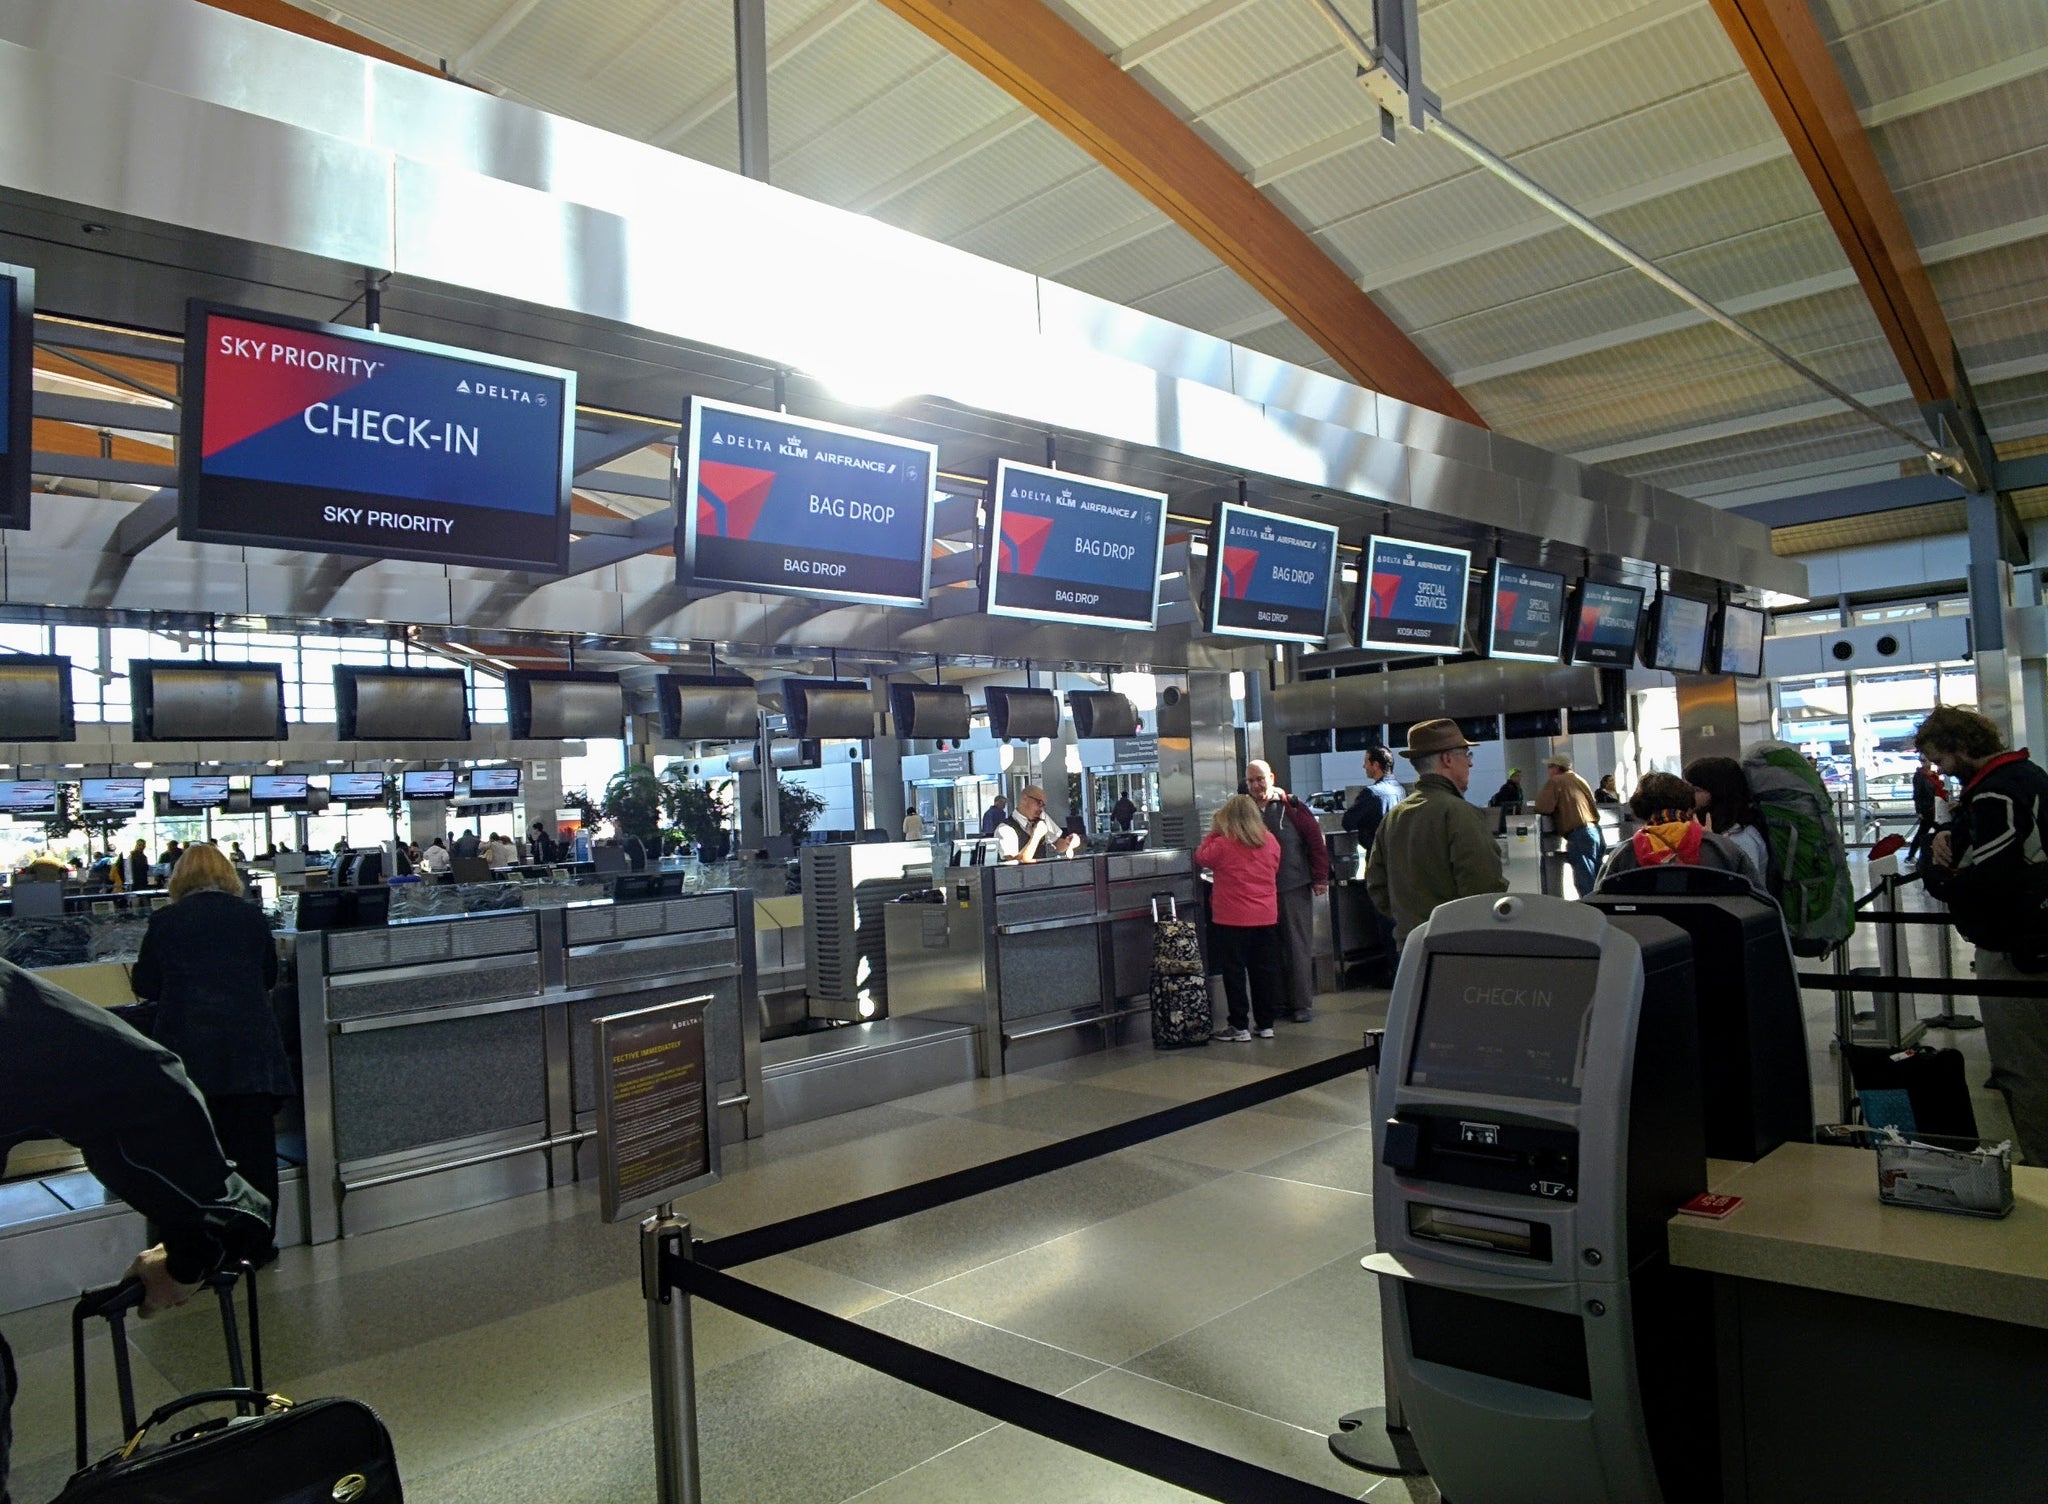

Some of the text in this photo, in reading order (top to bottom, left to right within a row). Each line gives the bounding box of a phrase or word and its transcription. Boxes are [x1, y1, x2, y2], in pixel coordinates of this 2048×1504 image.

[220, 335, 267, 360] SKY
[475, 383, 531, 404] DELTA
[304, 402, 478, 457] CHECK-IN
[727, 434, 885, 473] DELTA KLM AIRFRANCE
[809, 494, 895, 524] BAG DROP
[1021, 489, 1130, 518] DELTA KLM AIRFRANCE
[323, 505, 454, 536] SKY PRIORITY
[1236, 526, 1258, 539] DELTA
[1260, 531, 1275, 542] KLM
[1075, 537, 1135, 560] BAG DROP
[783, 558, 846, 577] BAG DROP
[1382, 555, 1401, 565] DELTA
[1272, 565, 1314, 585] BAG DROP
[1055, 590, 1099, 604] BAG DROP
[1417, 582, 1446, 596] SPECIAL
[1414, 595, 1448, 610] SERVICES
[1529, 598, 1549, 611] SPECIAL
[1258, 611, 1288, 623] BAG DROP
[1527, 609, 1550, 623] SERVICES
[532, 761, 547, 780] E
[1463, 986, 1552, 1008] CHECK IN
[677, 1018, 698, 1028] DELTA
[640, 1041, 681, 1057] IMMEDIATELY
